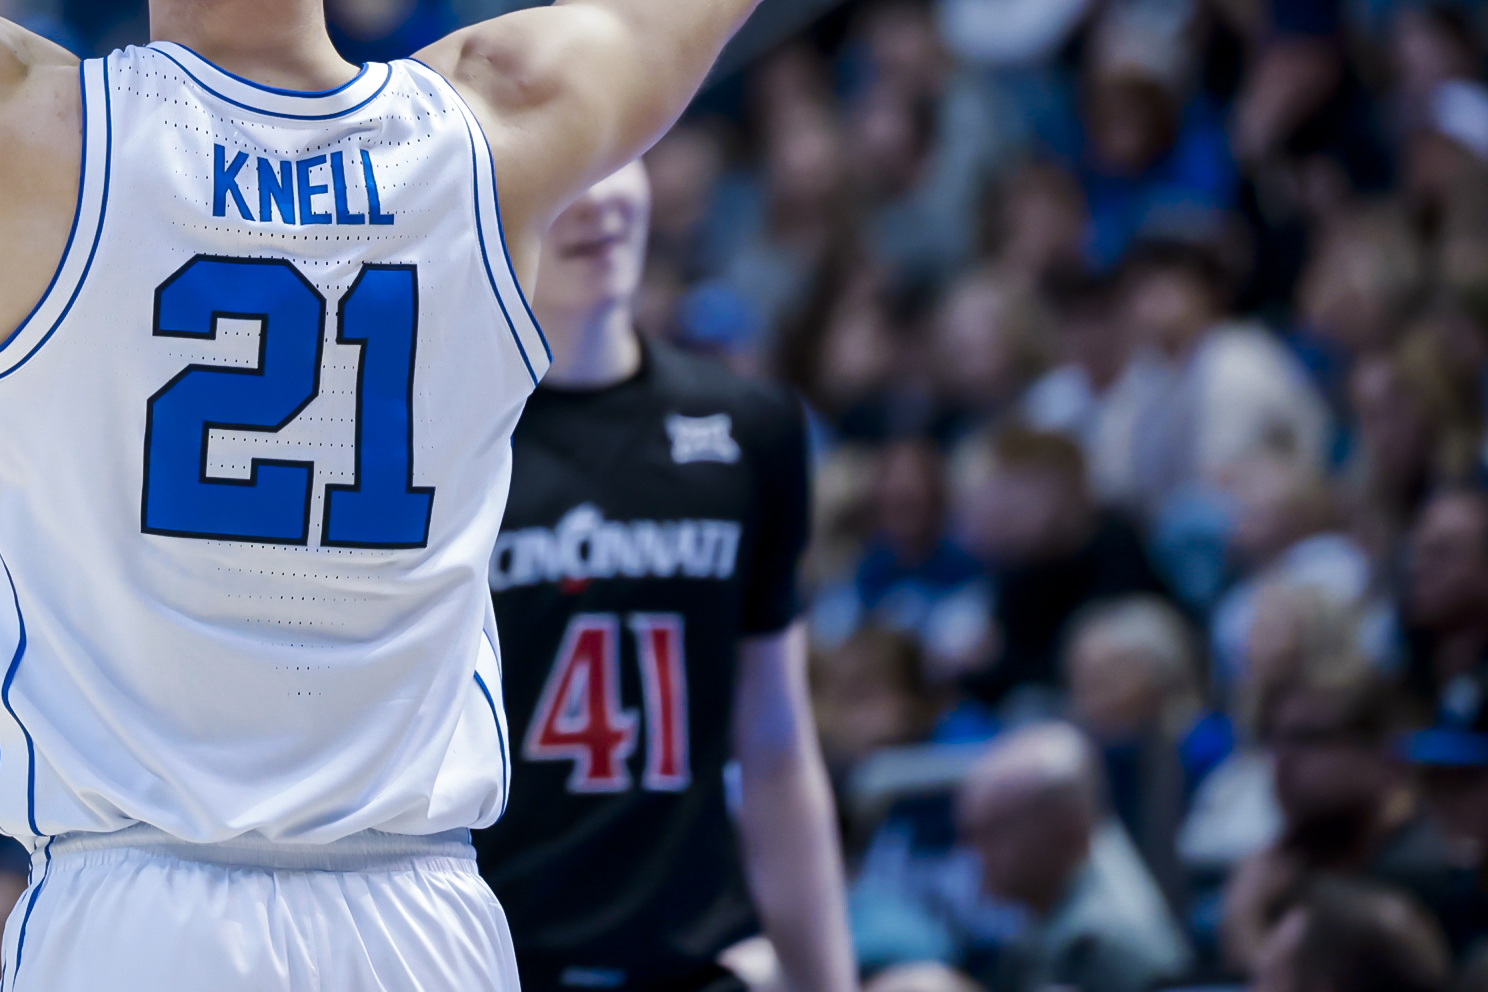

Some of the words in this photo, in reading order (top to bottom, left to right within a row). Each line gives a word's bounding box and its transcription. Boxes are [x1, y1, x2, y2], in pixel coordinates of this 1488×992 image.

[213, 144, 395, 225] KNELL
[141, 254, 436, 549] 21
[488, 504, 741, 591] CINCINNATI
[522, 614, 691, 793] 41
